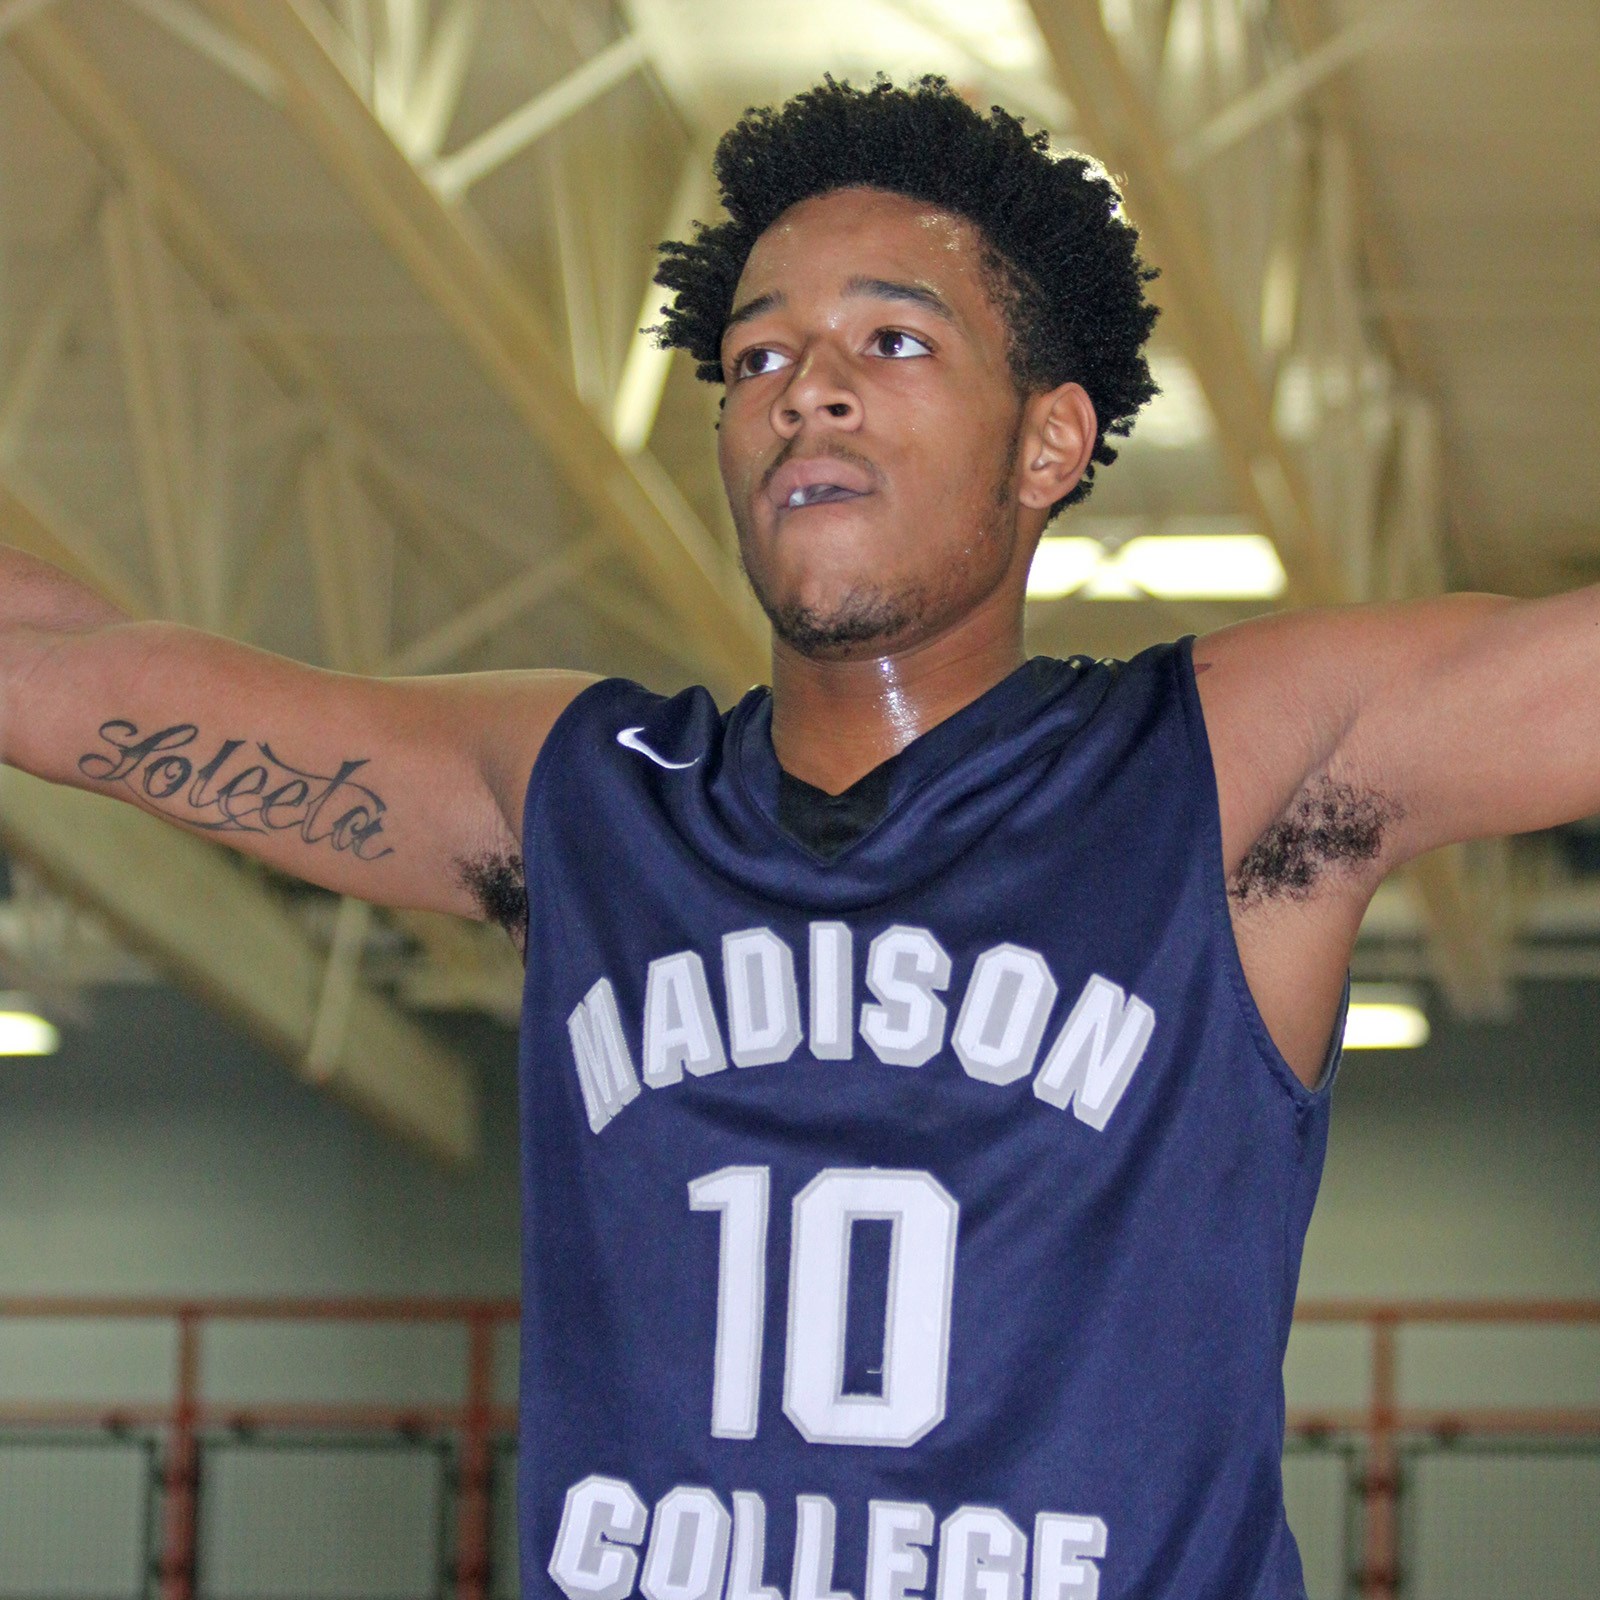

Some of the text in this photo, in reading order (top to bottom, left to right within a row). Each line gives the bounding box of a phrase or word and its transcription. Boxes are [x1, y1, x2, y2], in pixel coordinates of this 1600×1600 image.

[566, 921, 1156, 1135] MADISON
[687, 1165, 960, 1448] 10
[547, 1474, 1108, 1600] COLLEGE
